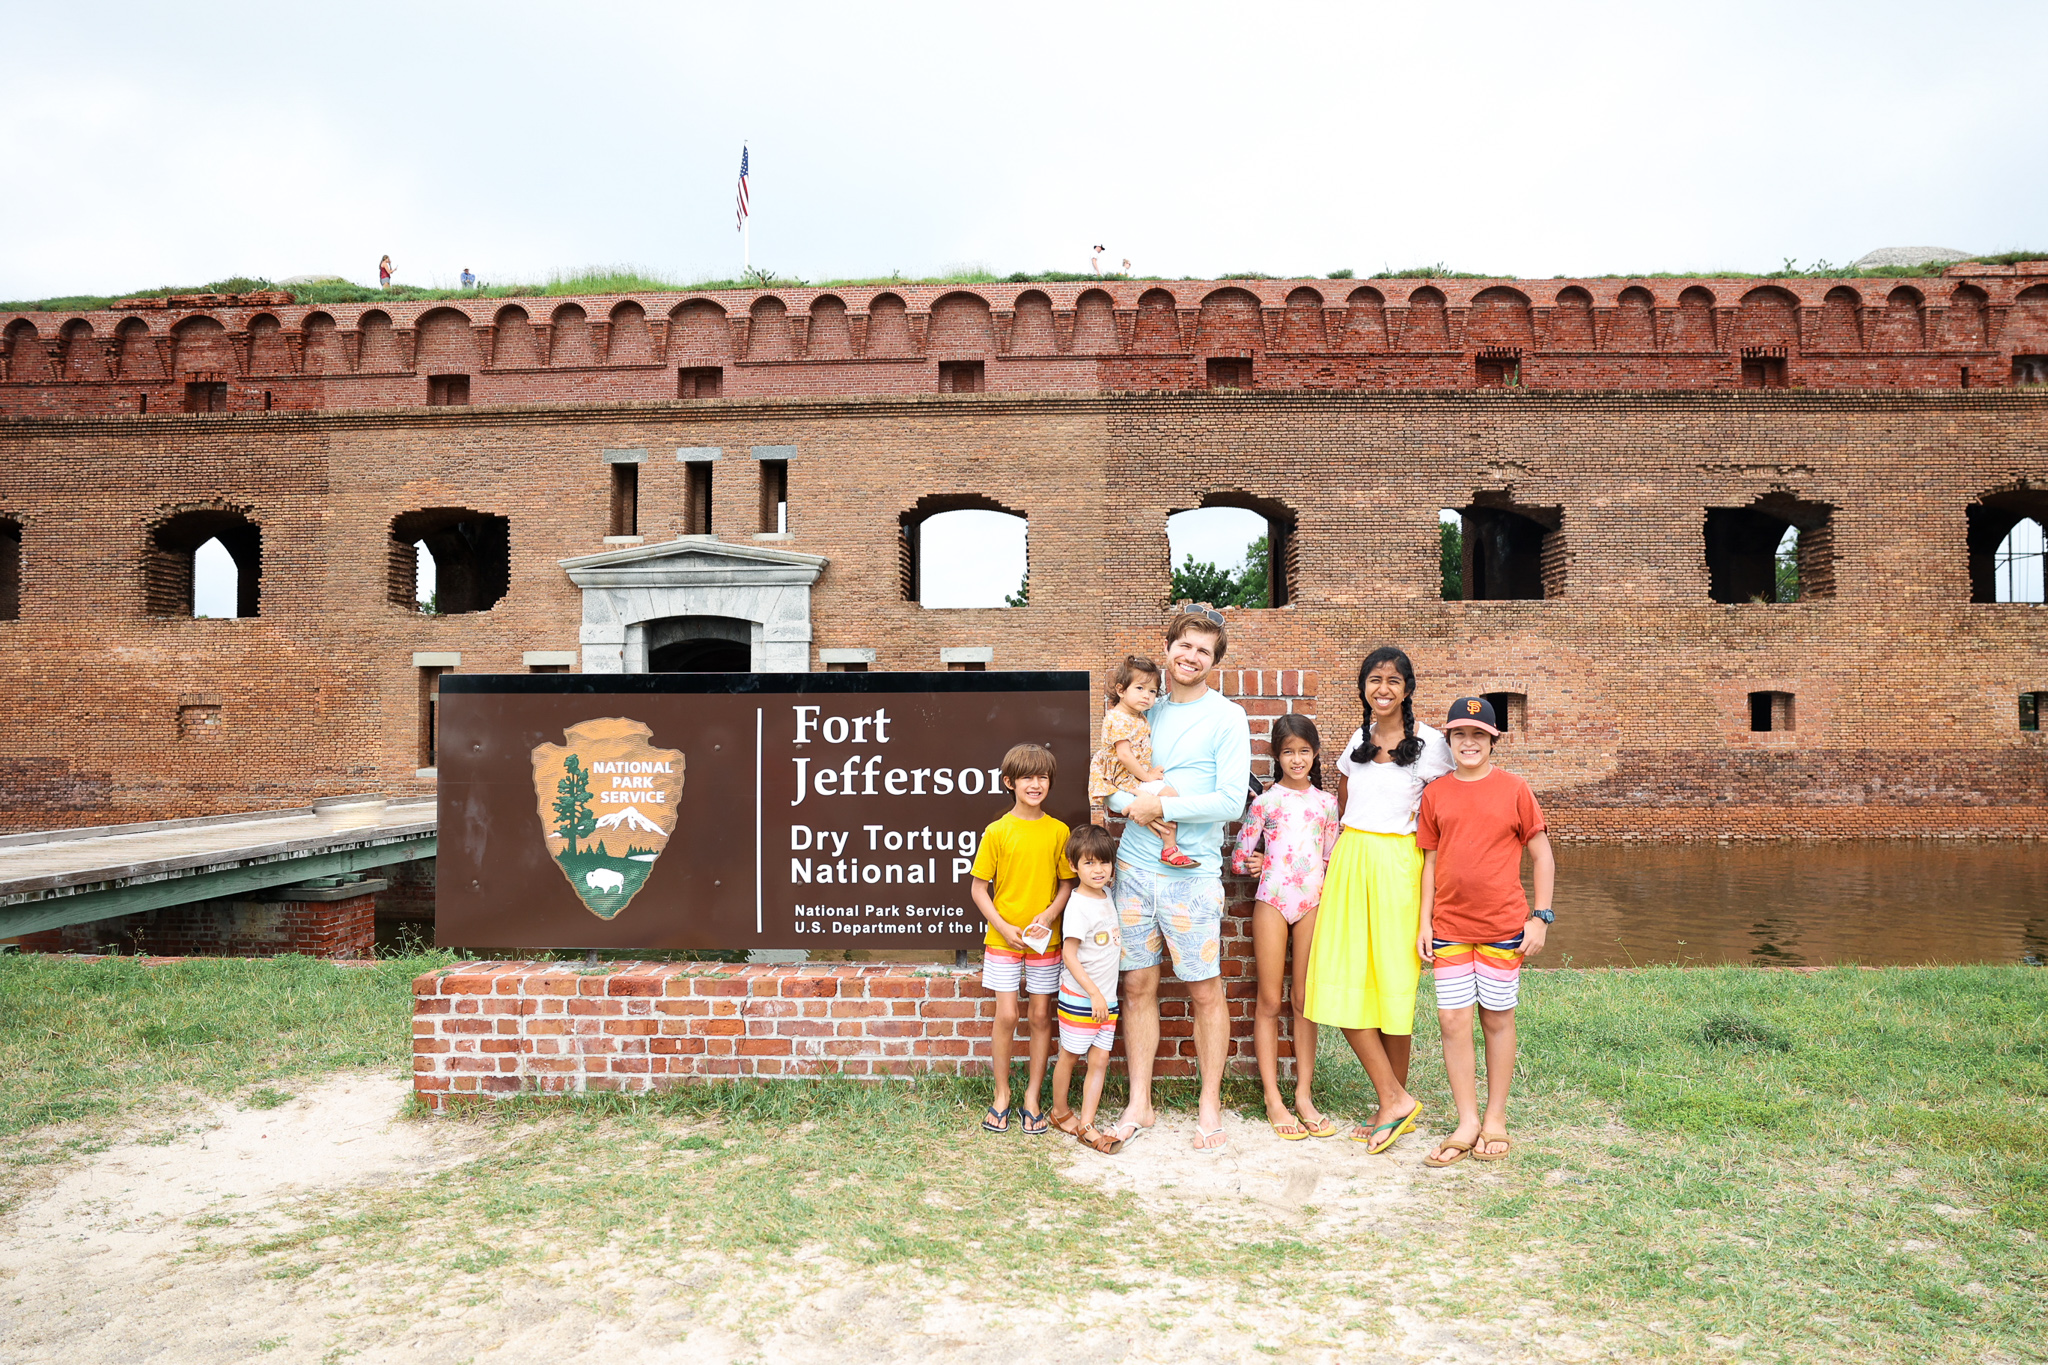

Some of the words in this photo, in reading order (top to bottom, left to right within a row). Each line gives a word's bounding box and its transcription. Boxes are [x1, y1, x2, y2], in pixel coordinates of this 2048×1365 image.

[792, 705, 891, 743] Fort
[593, 761, 674, 774] NATIONAL
[612, 776, 654, 788] PARK
[600, 791, 666, 803] SERVICE
[791, 825, 849, 857] Dry
[863, 825, 985, 857] Tortug
[791, 858, 936, 883] National
[795, 904, 859, 917] National
[865, 904, 900, 917] Park
[905, 904, 964, 917] Service
[795, 921, 826, 934] U.S.
[832, 921, 923, 937] Department
[928, 921, 944, 934] of
[949, 921, 973, 934] the
